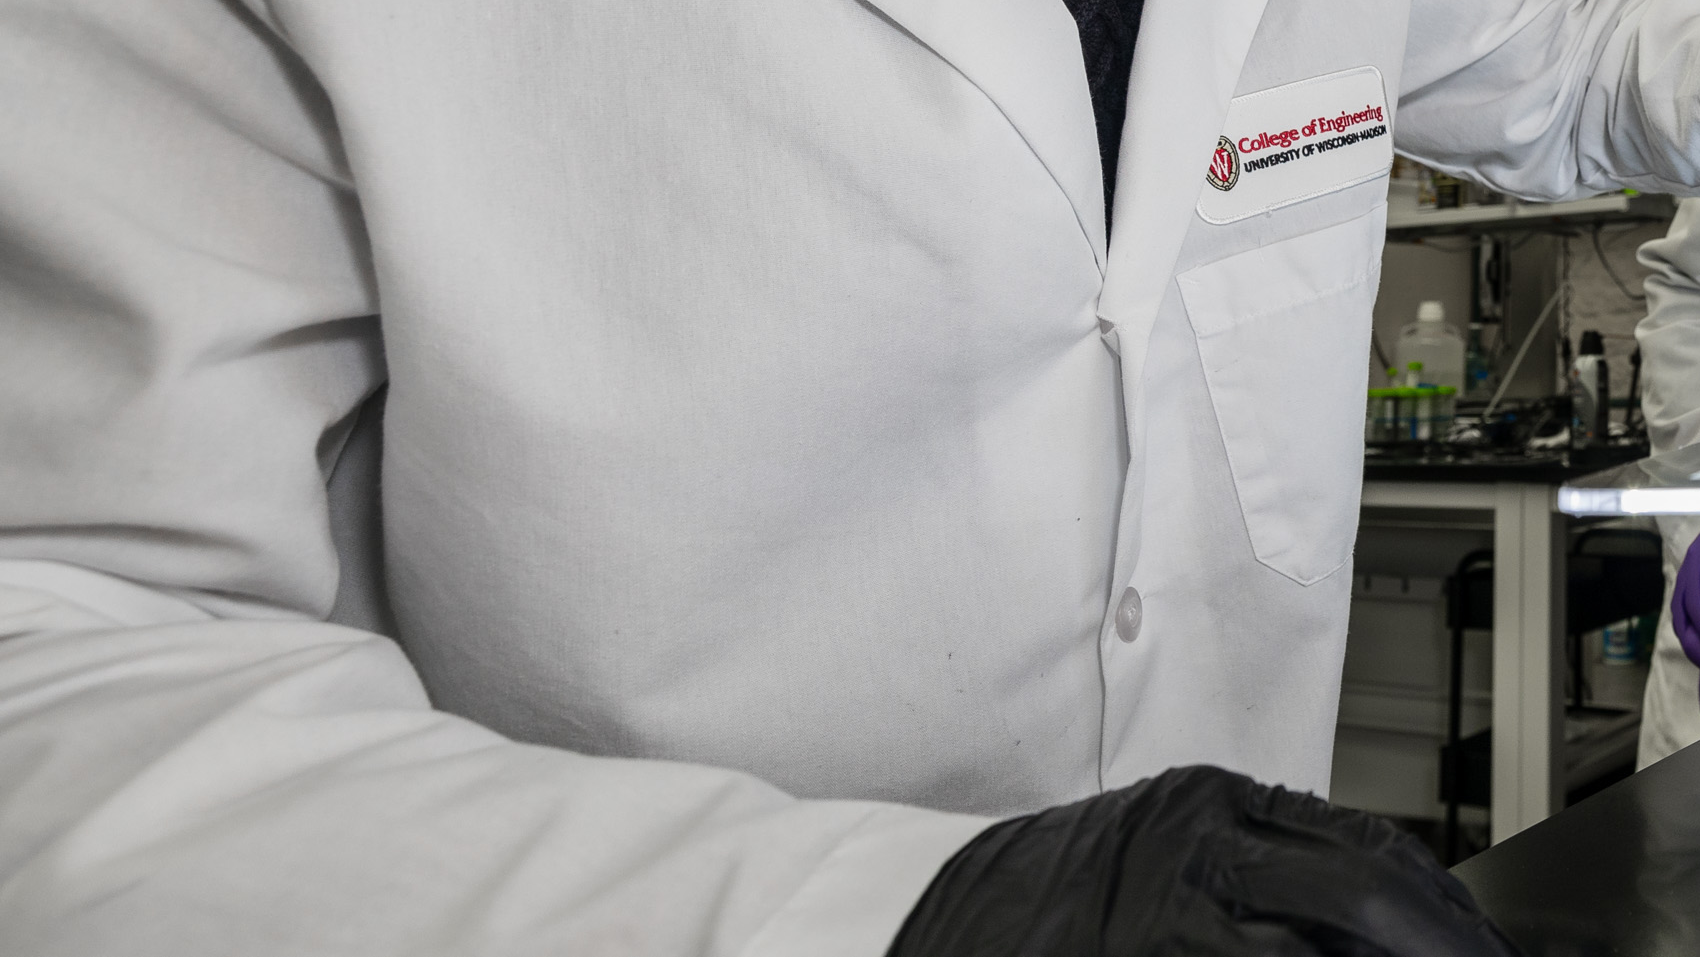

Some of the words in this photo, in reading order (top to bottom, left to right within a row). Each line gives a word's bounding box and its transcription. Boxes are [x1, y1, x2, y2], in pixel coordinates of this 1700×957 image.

[1238, 128, 1300, 154] College
[1301, 119, 1317, 138] of
[1318, 104, 1384, 133] Engineering
[1243, 148, 1300, 173] UNIVERSITY
[1302, 144, 1315, 157] OF
[1315, 125, 1387, 154] WISCONSIN-MADISON
